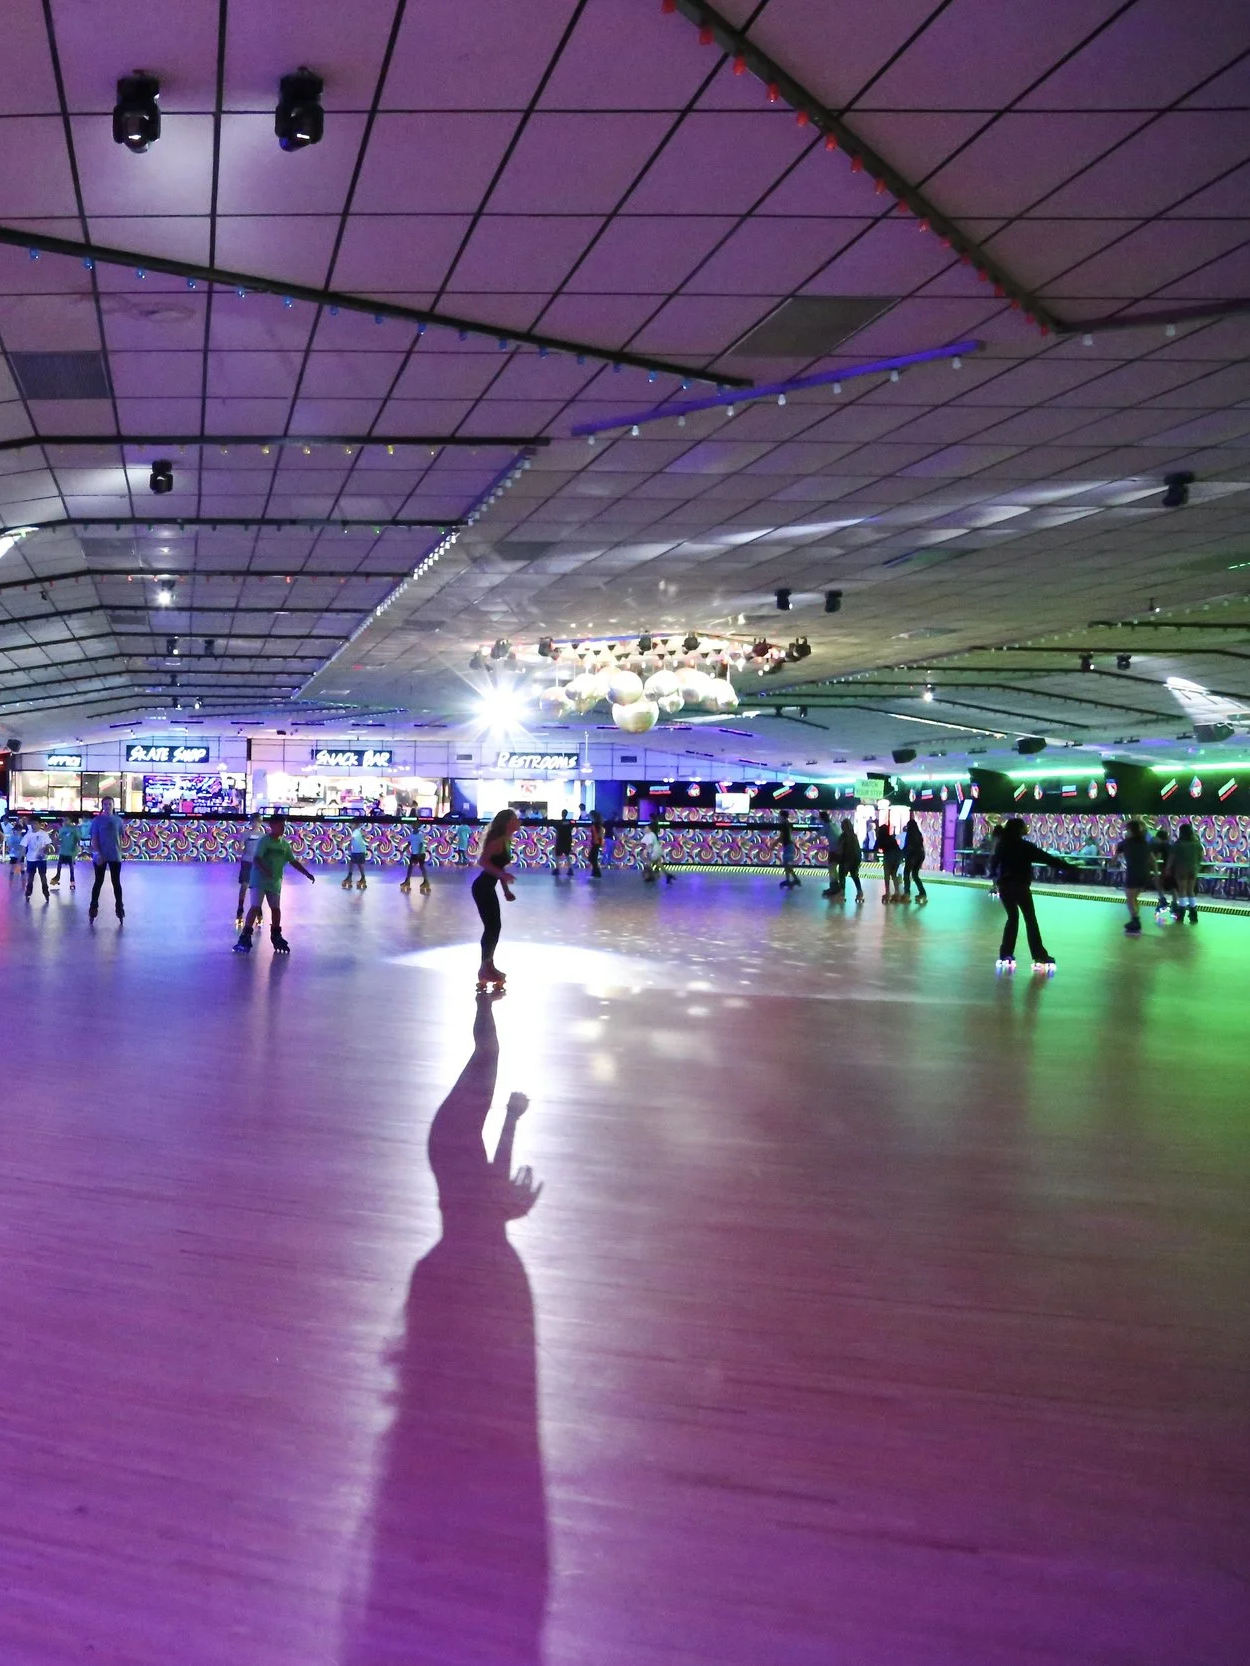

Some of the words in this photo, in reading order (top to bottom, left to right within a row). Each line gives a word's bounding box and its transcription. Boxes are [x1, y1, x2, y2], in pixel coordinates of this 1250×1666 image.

[128, 745, 170, 762] SKATE
[172, 746, 207, 763] SHOP
[315, 749, 359, 767] SNACK
[362, 750, 391, 768] BAR
[497, 752, 578, 769] RESTROOMS
